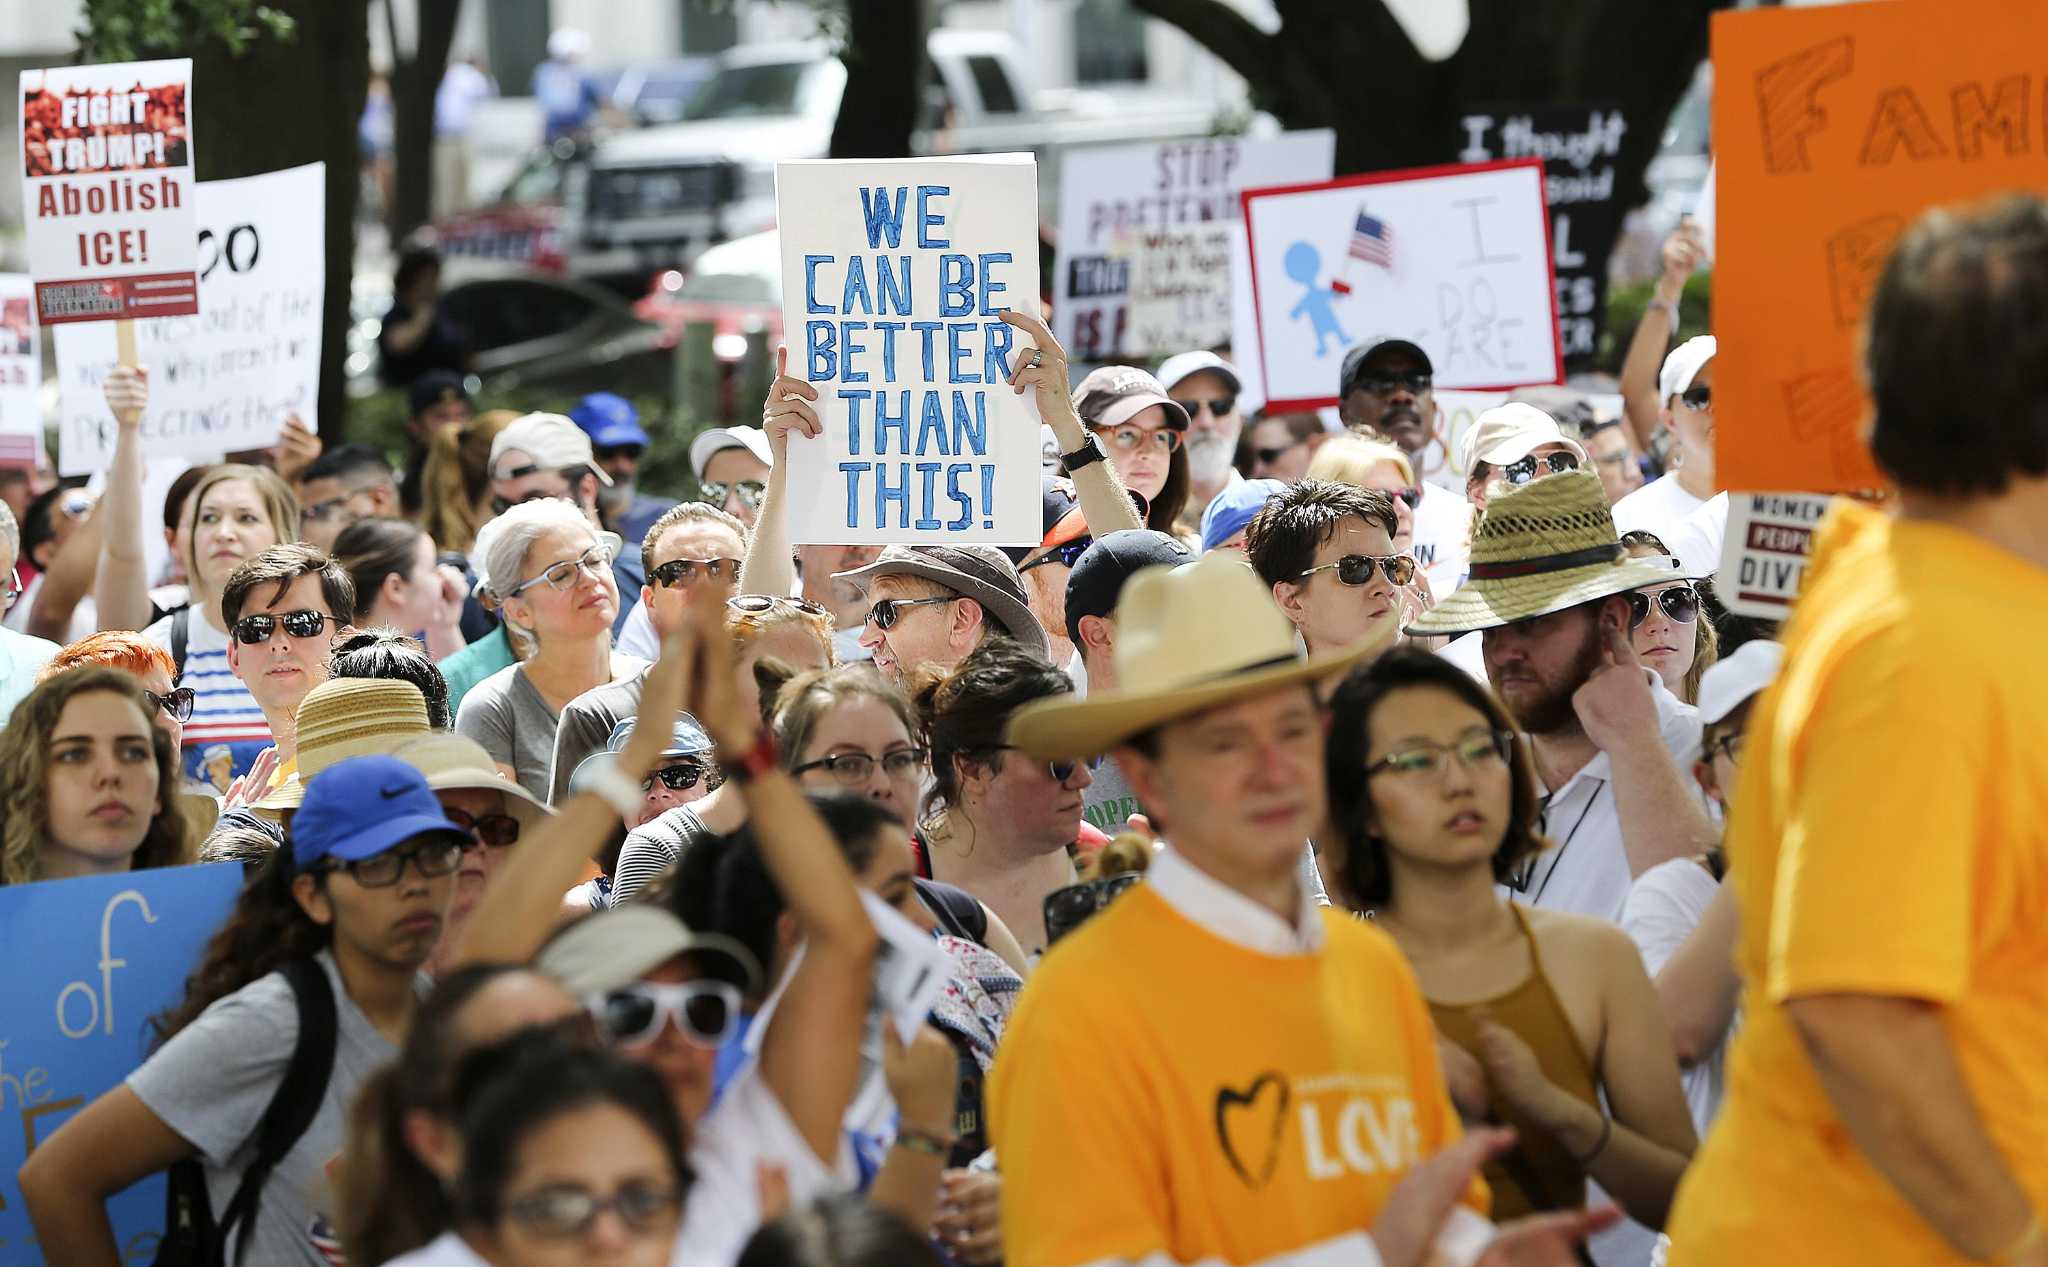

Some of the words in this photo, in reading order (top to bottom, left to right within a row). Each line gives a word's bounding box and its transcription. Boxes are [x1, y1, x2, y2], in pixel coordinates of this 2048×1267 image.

[61, 92, 149, 129] FIGHT
[1754, 34, 2048, 175] FAM
[47, 131, 165, 171] TRUMP!
[1156, 142, 1239, 190] STOP
[39, 176, 181, 217] Abolish
[859, 186, 950, 249] WE
[79, 229, 149, 266] ICE!
[1452, 196, 1521, 268] I
[804, 254, 913, 316] CAN
[939, 252, 1013, 318] BE
[1437, 276, 1498, 330] DO
[806, 320, 1014, 384] BETTER
[838, 390, 986, 455] THAN
[839, 462, 995, 530] THIS!
[1739, 556, 1805, 590] DIV
[56, 890, 158, 1039] of
